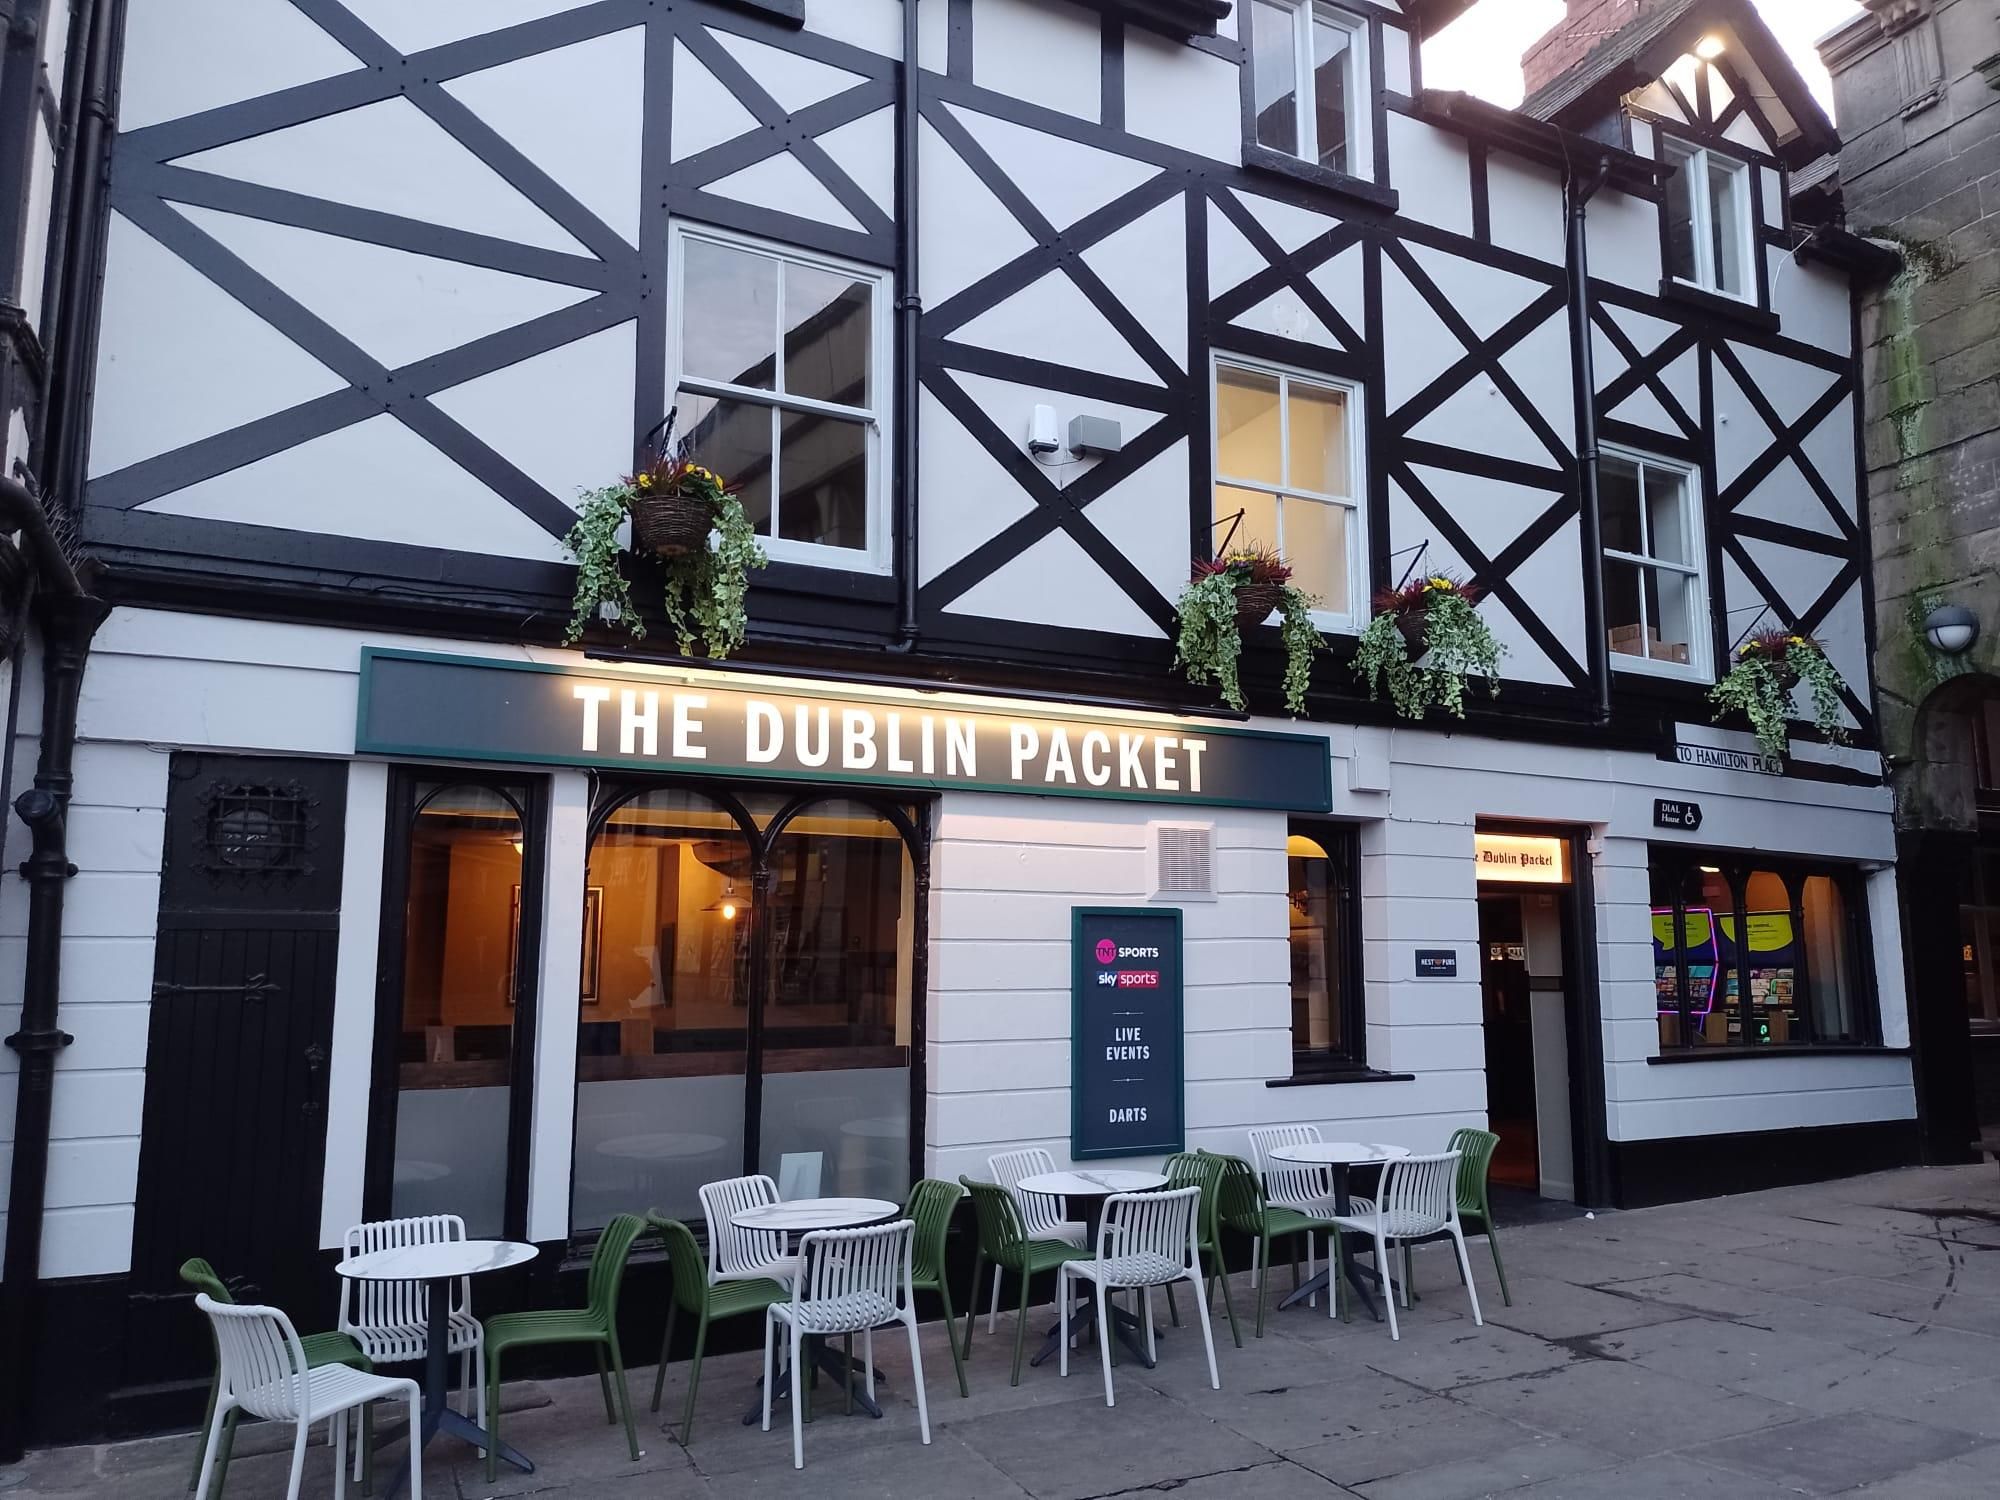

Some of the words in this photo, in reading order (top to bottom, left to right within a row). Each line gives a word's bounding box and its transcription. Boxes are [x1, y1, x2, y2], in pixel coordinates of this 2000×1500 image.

[574, 685, 708, 760] THE
[745, 699, 978, 778] DUBLIN
[1009, 723, 1209, 794] PACKET
[1680, 747, 1692, 761] TO
[1696, 749, 1748, 769] HAMILTON
[1662, 803, 1680, 814] DIAL
[1483, 850, 1517, 865] Dublin
[1520, 852, 1553, 867] Packet
[1118, 947, 1159, 958] SPORTS
[1098, 971, 1117, 987] sky
[1120, 972, 1157, 987] sports
[1115, 1027, 1141, 1041] LIVE
[1106, 1045, 1150, 1061] EVENTS
[1109, 1107, 1147, 1123] DARTS
